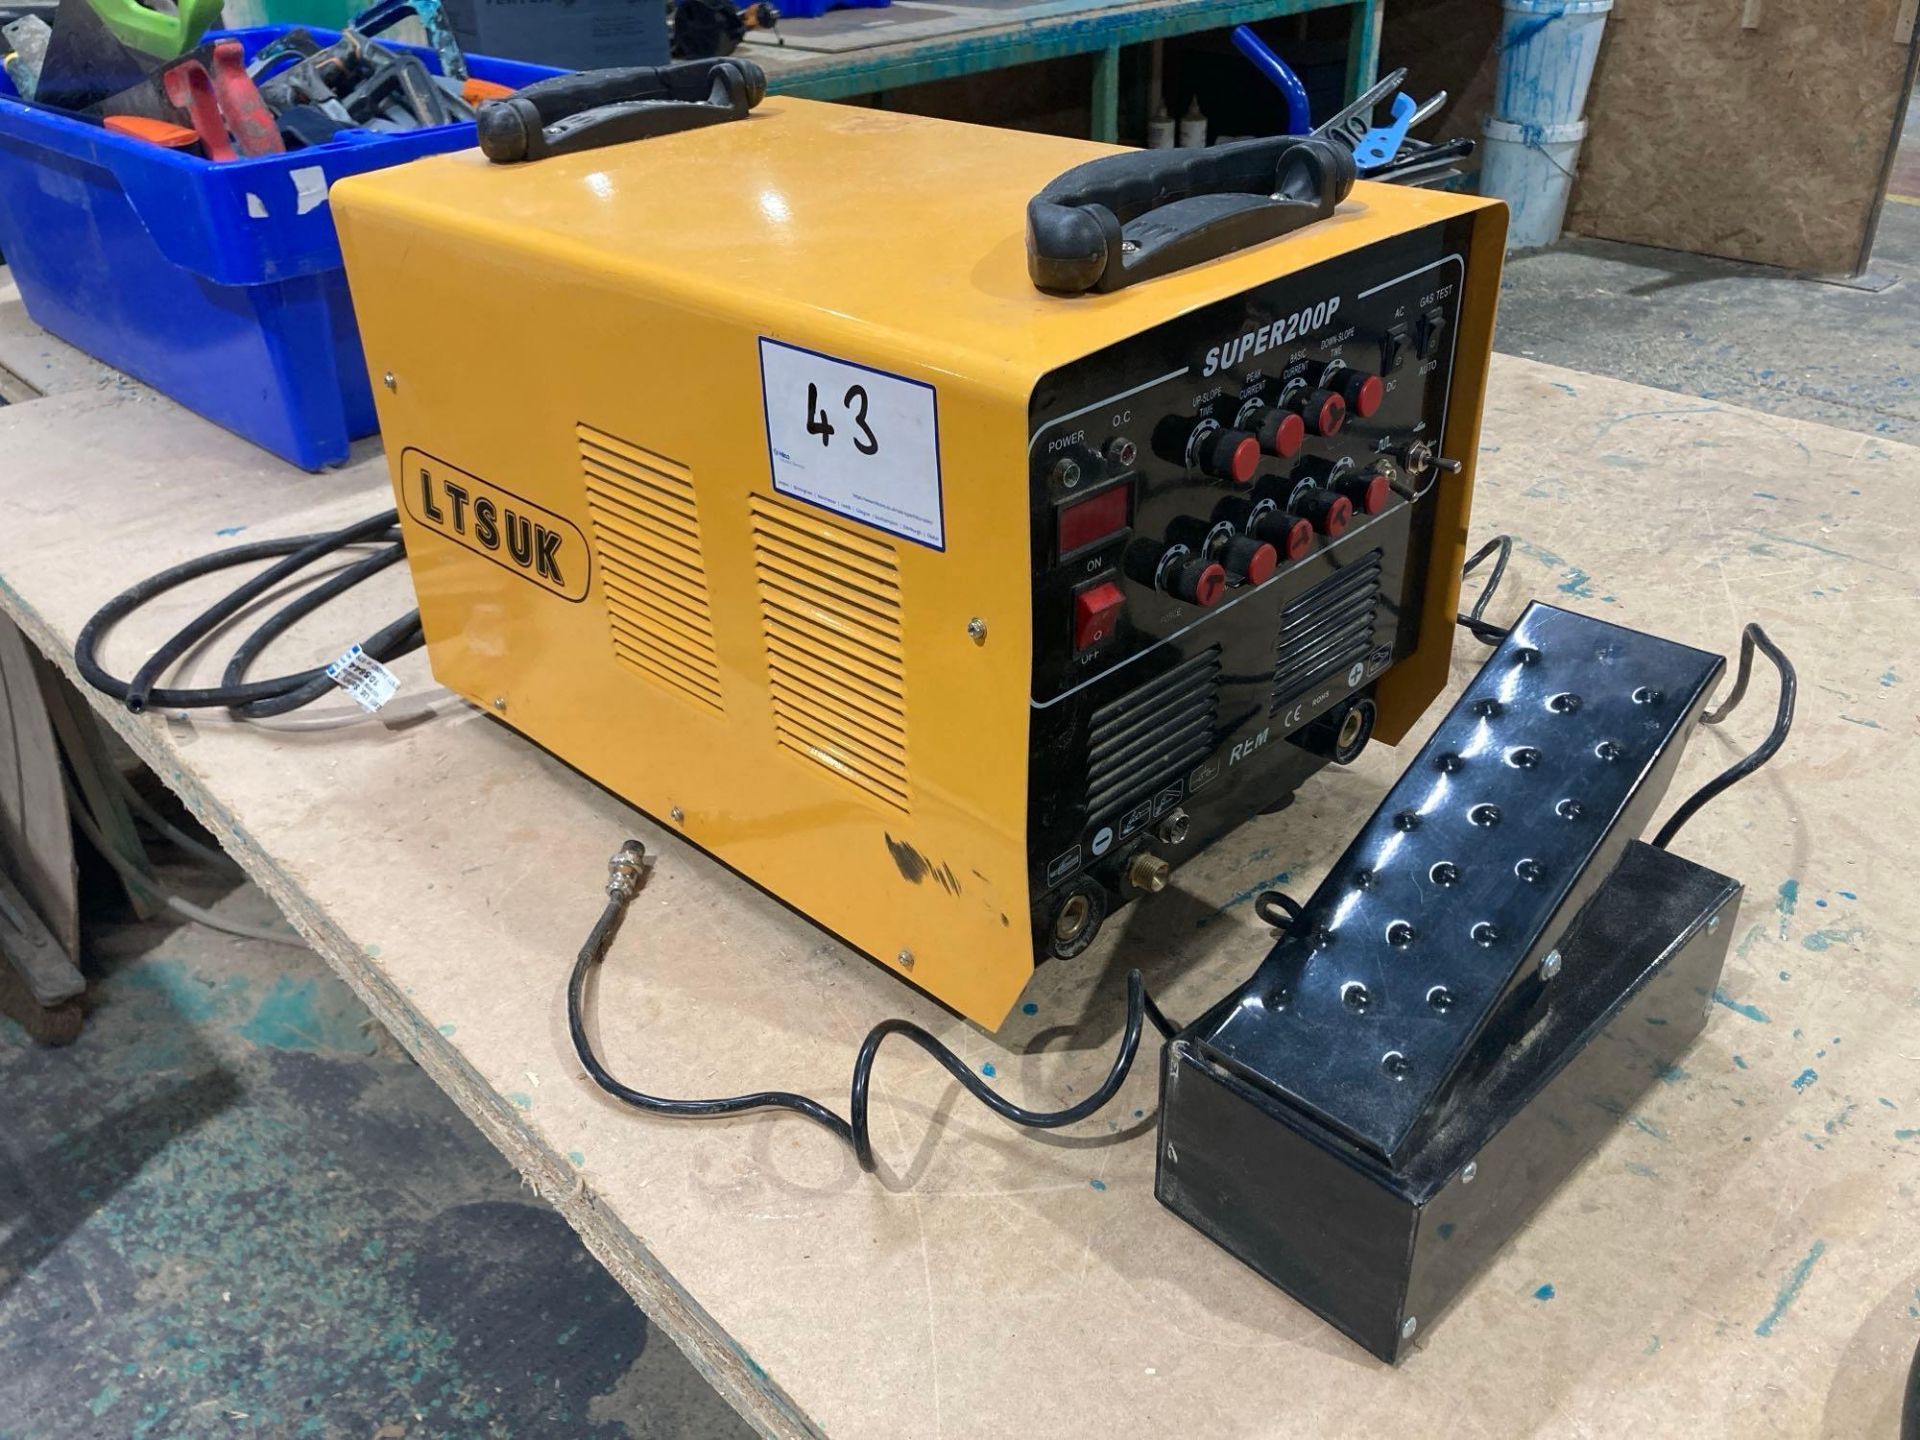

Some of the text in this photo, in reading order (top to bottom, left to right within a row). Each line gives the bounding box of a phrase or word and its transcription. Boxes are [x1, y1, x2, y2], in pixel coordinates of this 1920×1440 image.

[1420, 284, 1453, 307] GAS TEST
[1394, 306, 1405, 318] AC
[1203, 296, 1340, 377] SUPER200P
[1320, 326, 1355, 350] DOWN-SLOPE
[1290, 348, 1306, 363] BASIC
[1246, 369, 1262, 383] PEAK
[1283, 361, 1309, 379] CURRENT
[1418, 360, 1437, 376] AUTO
[1239, 380, 1266, 400] CURRENT
[1386, 379, 1397, 392] DC
[1192, 387, 1222, 407] UP-SLOPE
[807, 382, 878, 455] 43
[1048, 430, 1085, 453] POWER
[420, 468, 565, 587] LTSUK
[1087, 557, 1101, 571] ON
[1229, 727, 1269, 766] REM
